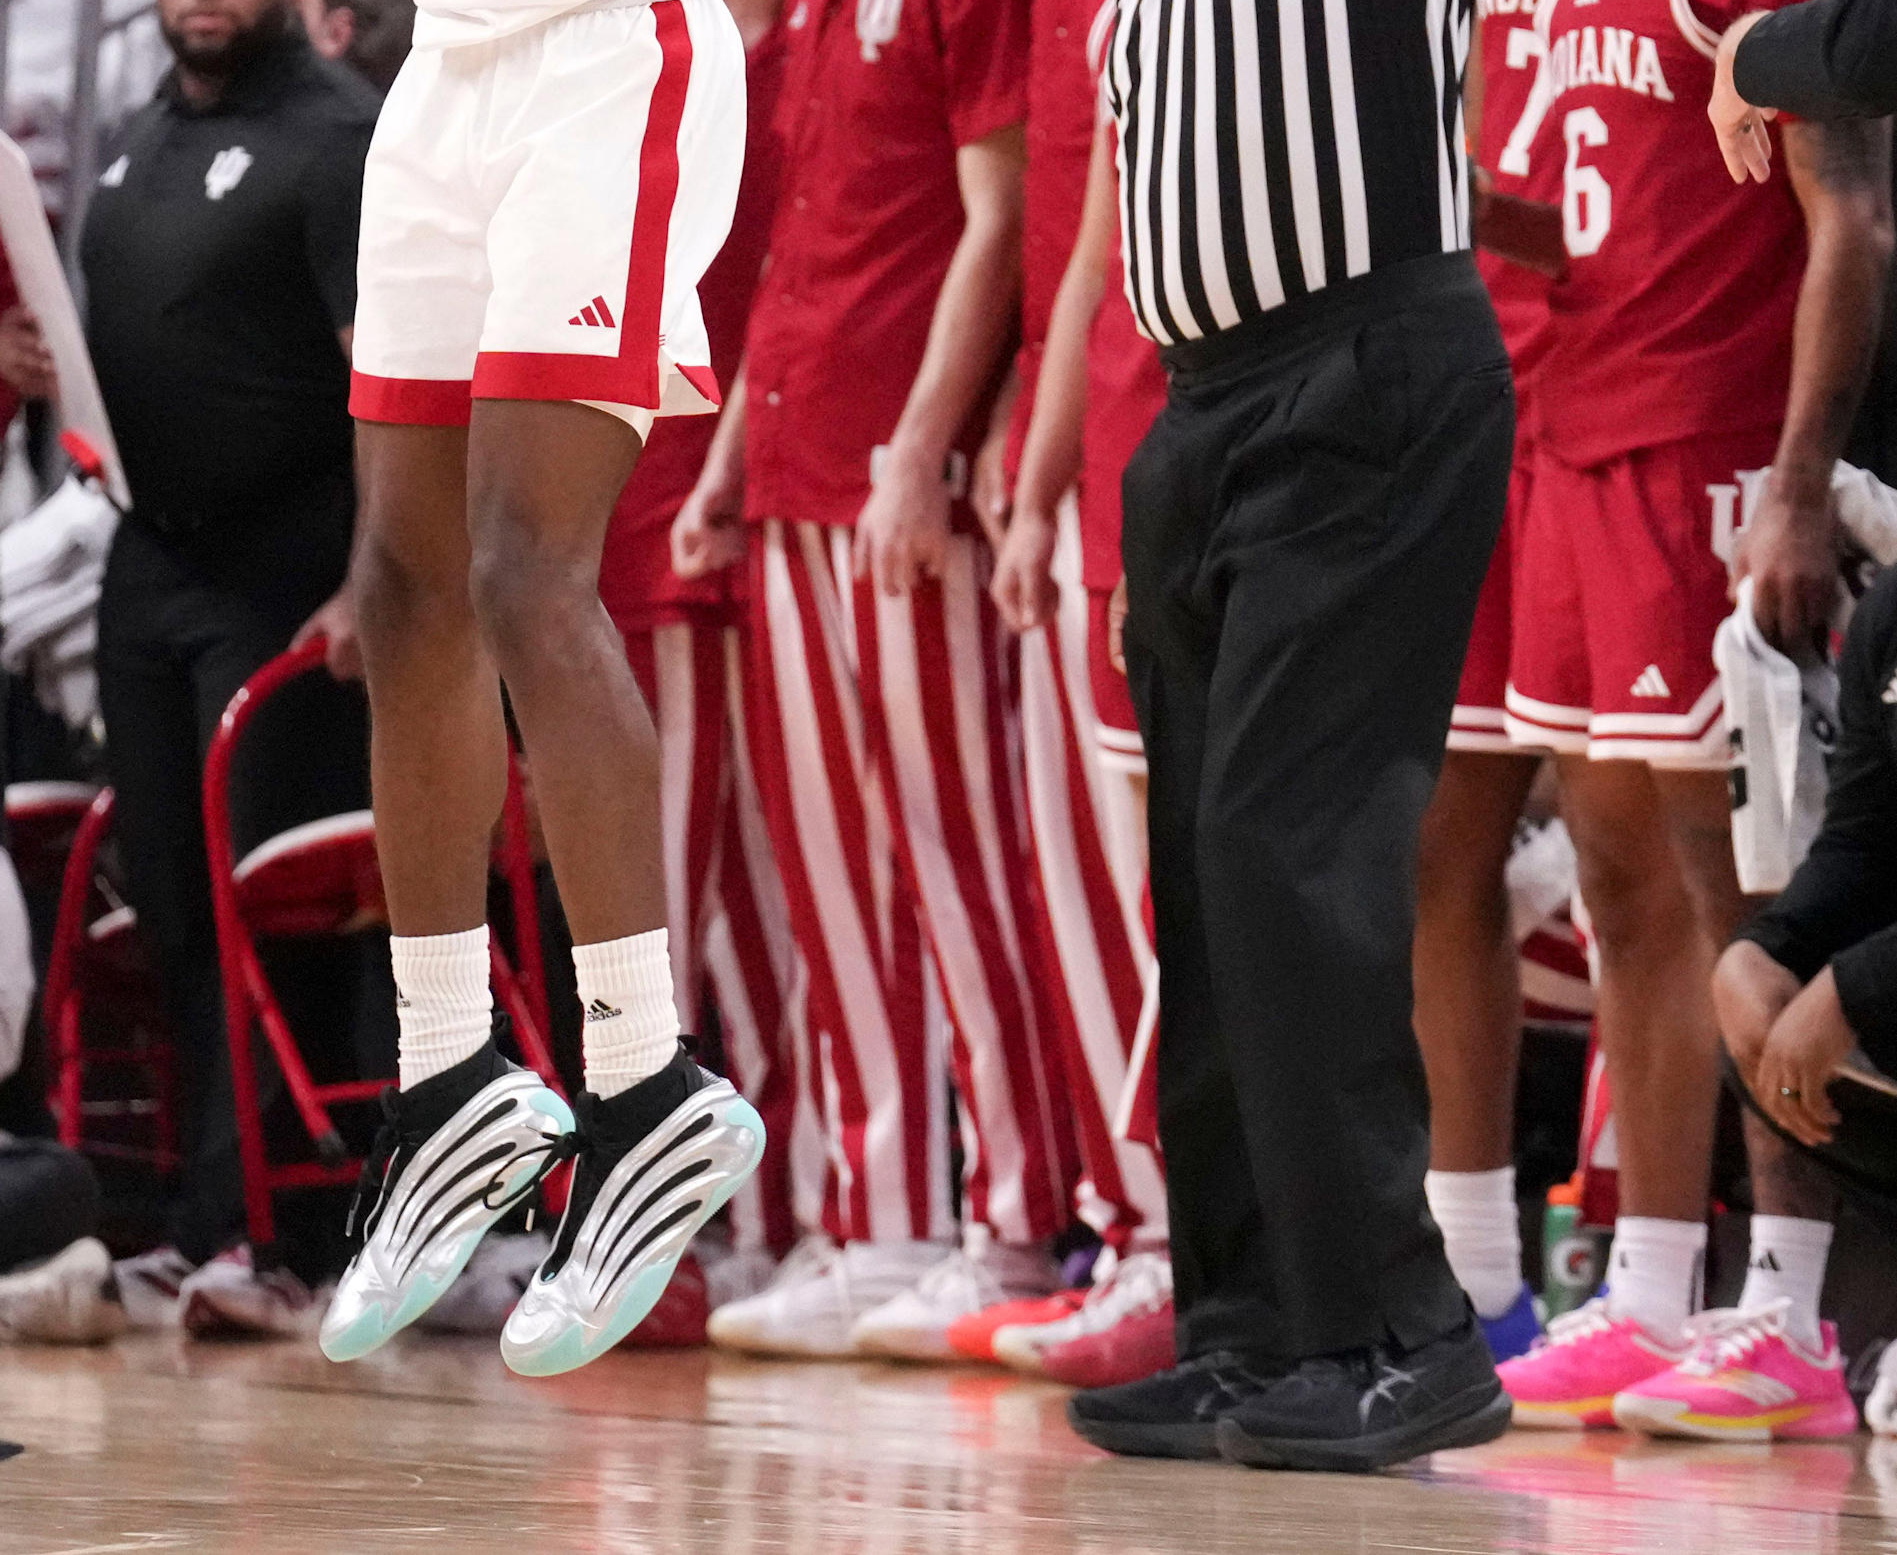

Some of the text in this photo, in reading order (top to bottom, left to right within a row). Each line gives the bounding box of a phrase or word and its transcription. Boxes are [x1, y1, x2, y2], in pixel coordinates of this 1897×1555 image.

[205, 146, 254, 200] IU
[1499, 28, 1551, 177] 7
[1563, 106, 1612, 258] 6
